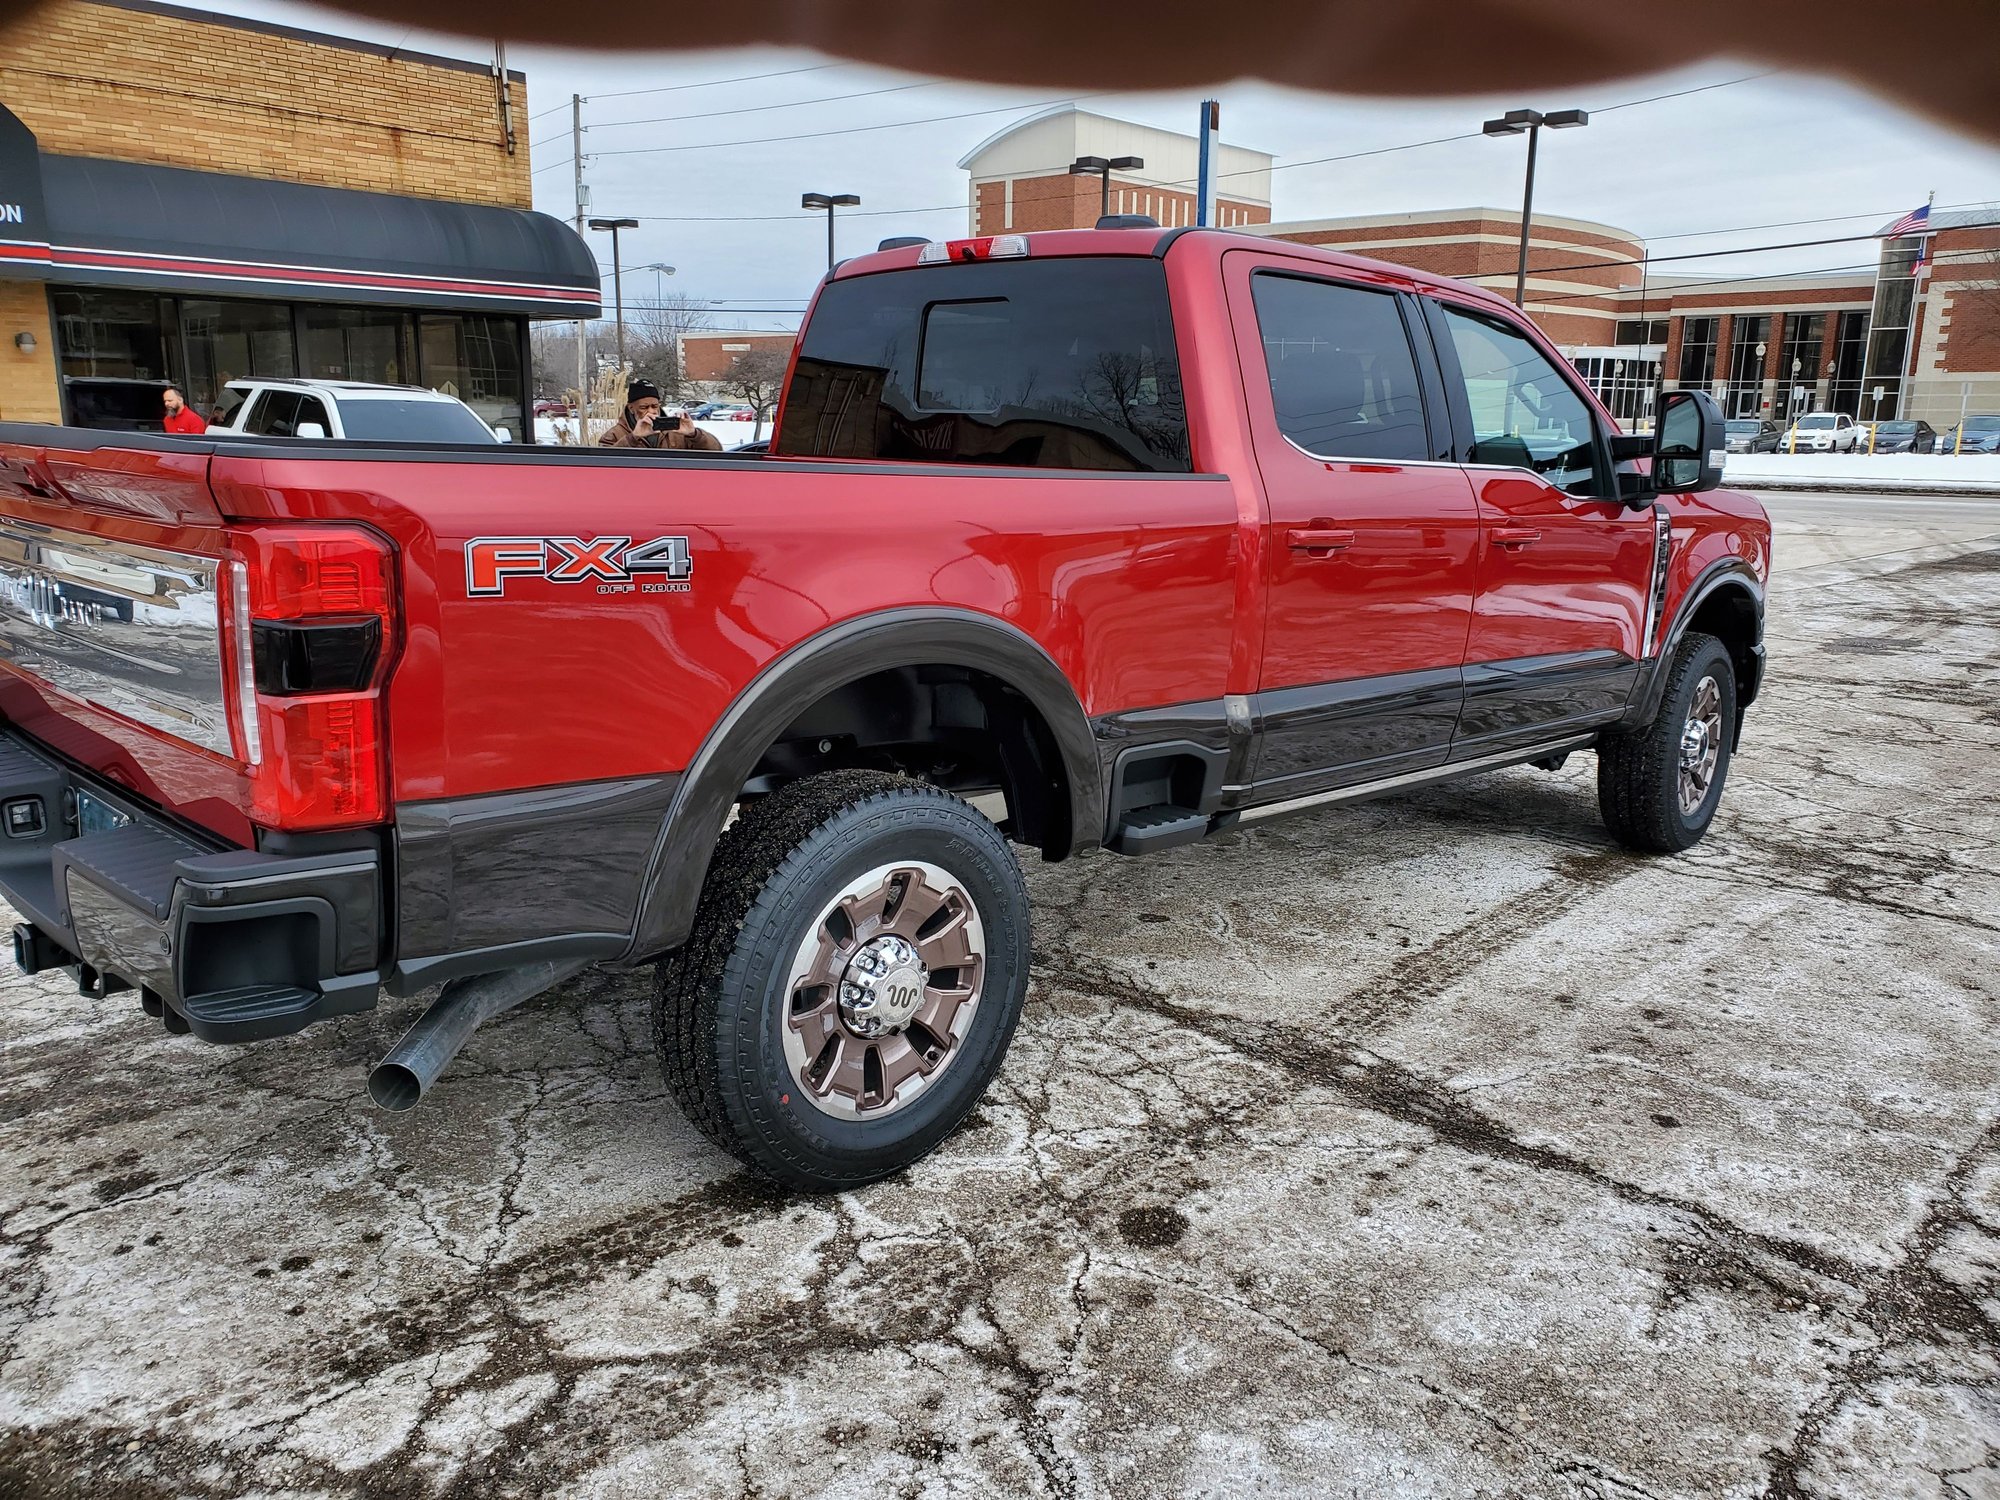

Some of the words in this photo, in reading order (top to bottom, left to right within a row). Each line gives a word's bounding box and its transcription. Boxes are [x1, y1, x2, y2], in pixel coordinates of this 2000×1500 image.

[464, 536, 693, 598] FX4
[596, 584, 636, 594] OFF
[641, 583, 692, 593] ROAD
